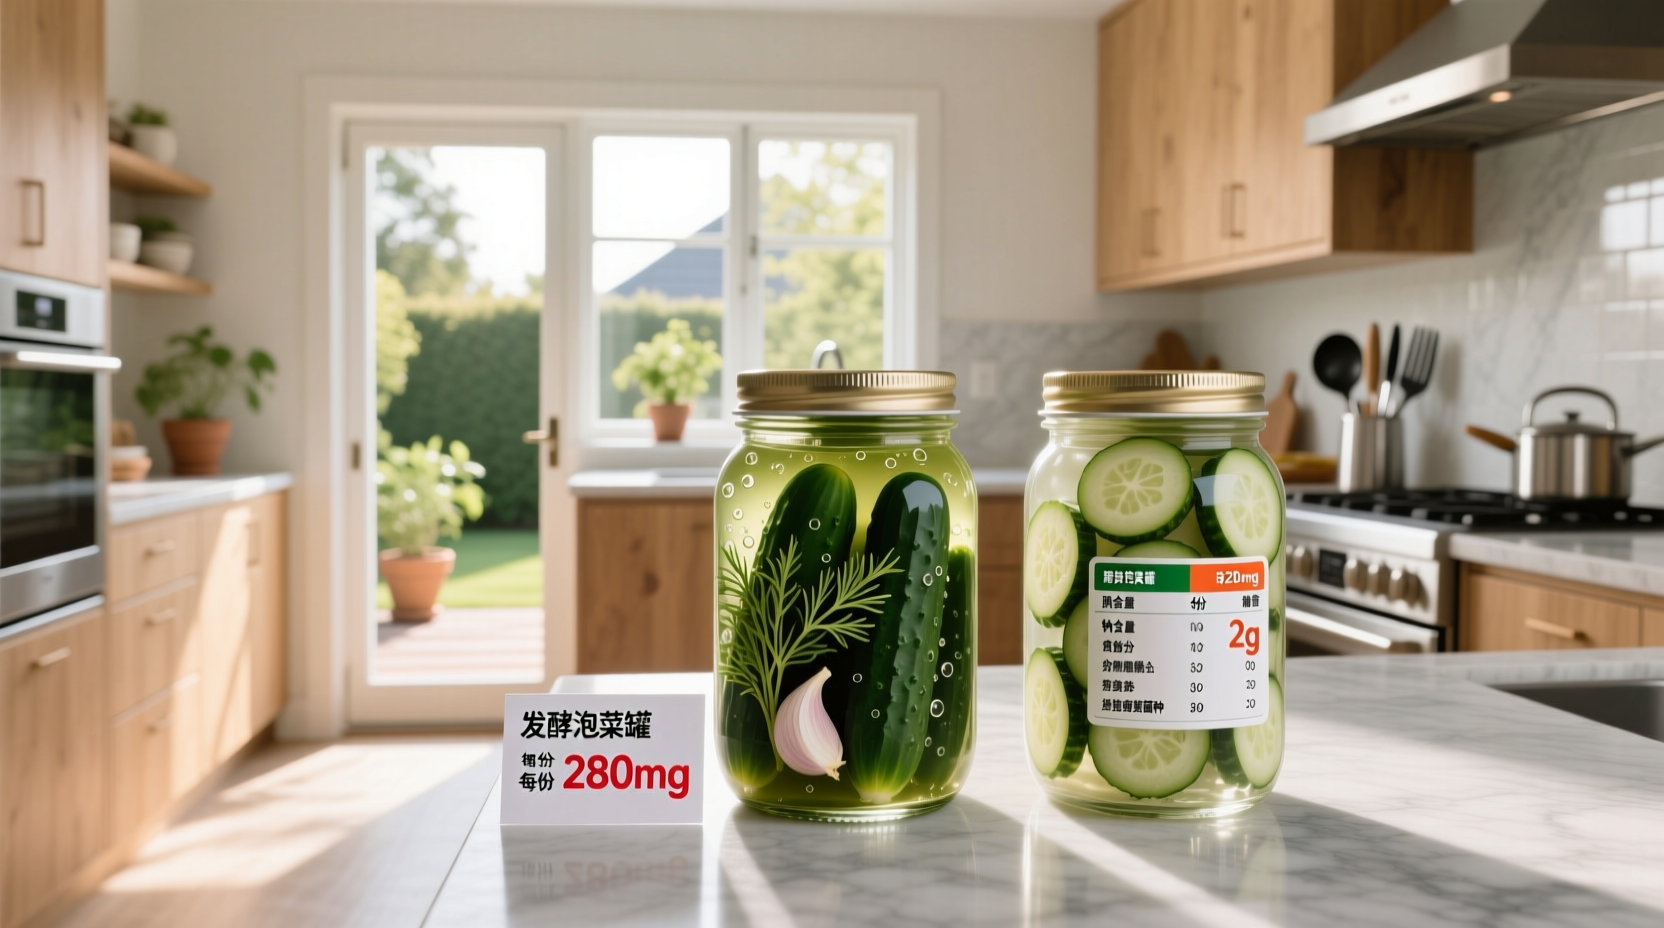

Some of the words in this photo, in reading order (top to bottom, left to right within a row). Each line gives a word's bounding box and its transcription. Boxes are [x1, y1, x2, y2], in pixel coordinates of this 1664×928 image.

[1229, 619, 1259, 655] 2g
[521, 710, 652, 739] 发酵泡菜罐
[519, 772, 554, 792] 每份
[563, 755, 689, 799] 280mg
